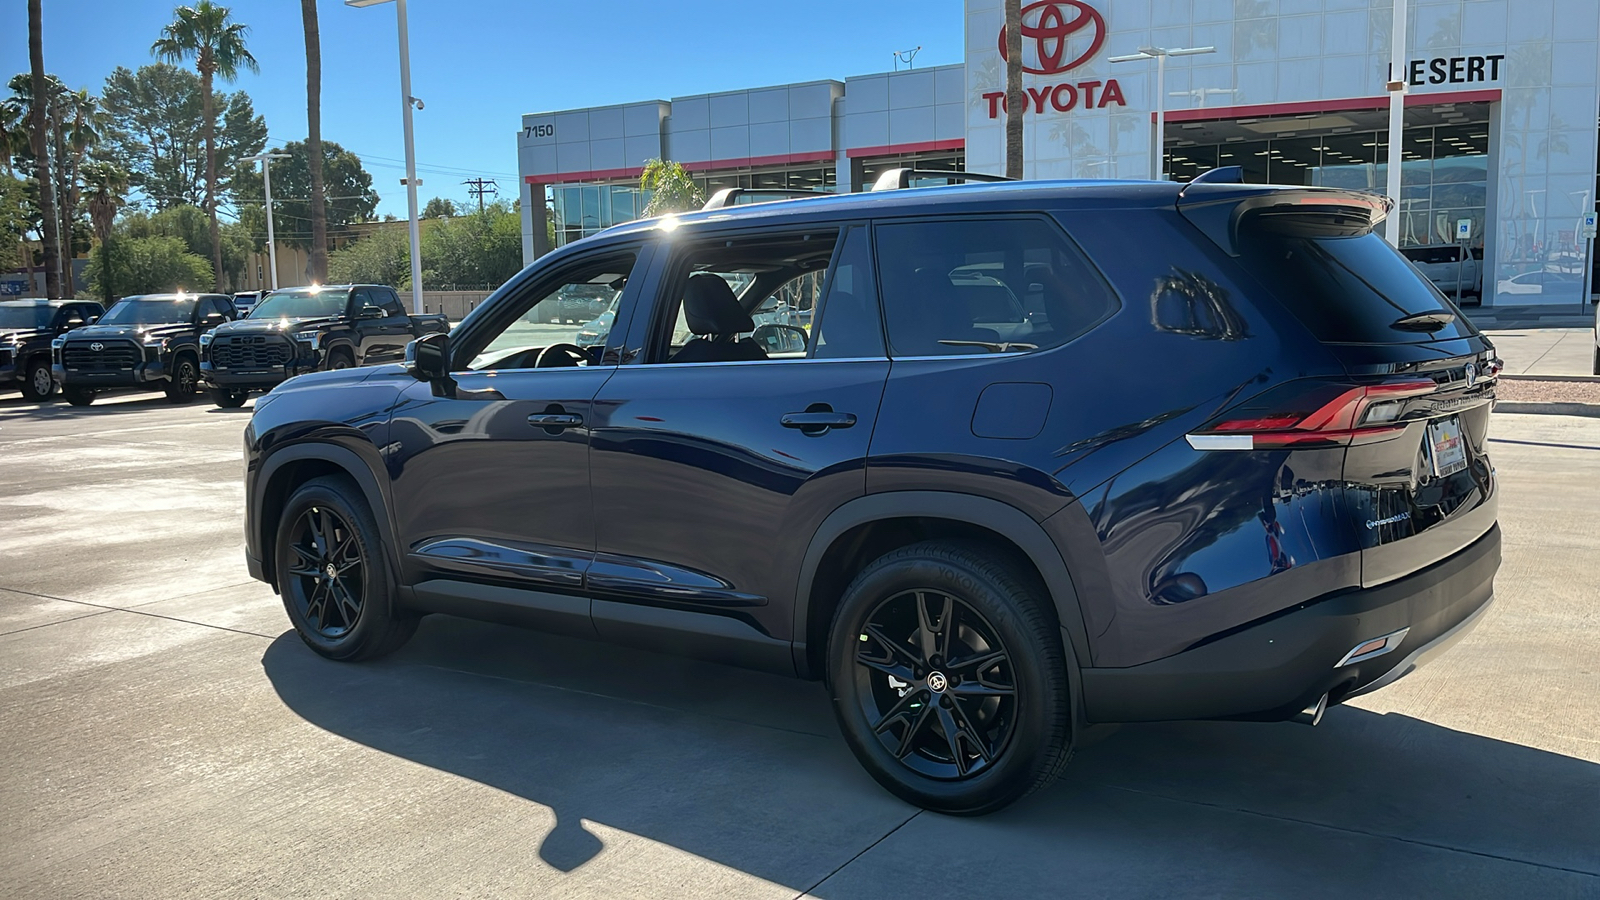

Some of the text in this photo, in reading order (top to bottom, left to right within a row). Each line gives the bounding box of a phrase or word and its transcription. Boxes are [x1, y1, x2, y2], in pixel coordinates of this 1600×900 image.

[1388, 55, 1505, 86] ESERT
[525, 124, 554, 139] 7150
[936, 566, 1008, 623] YOKOHAMA
